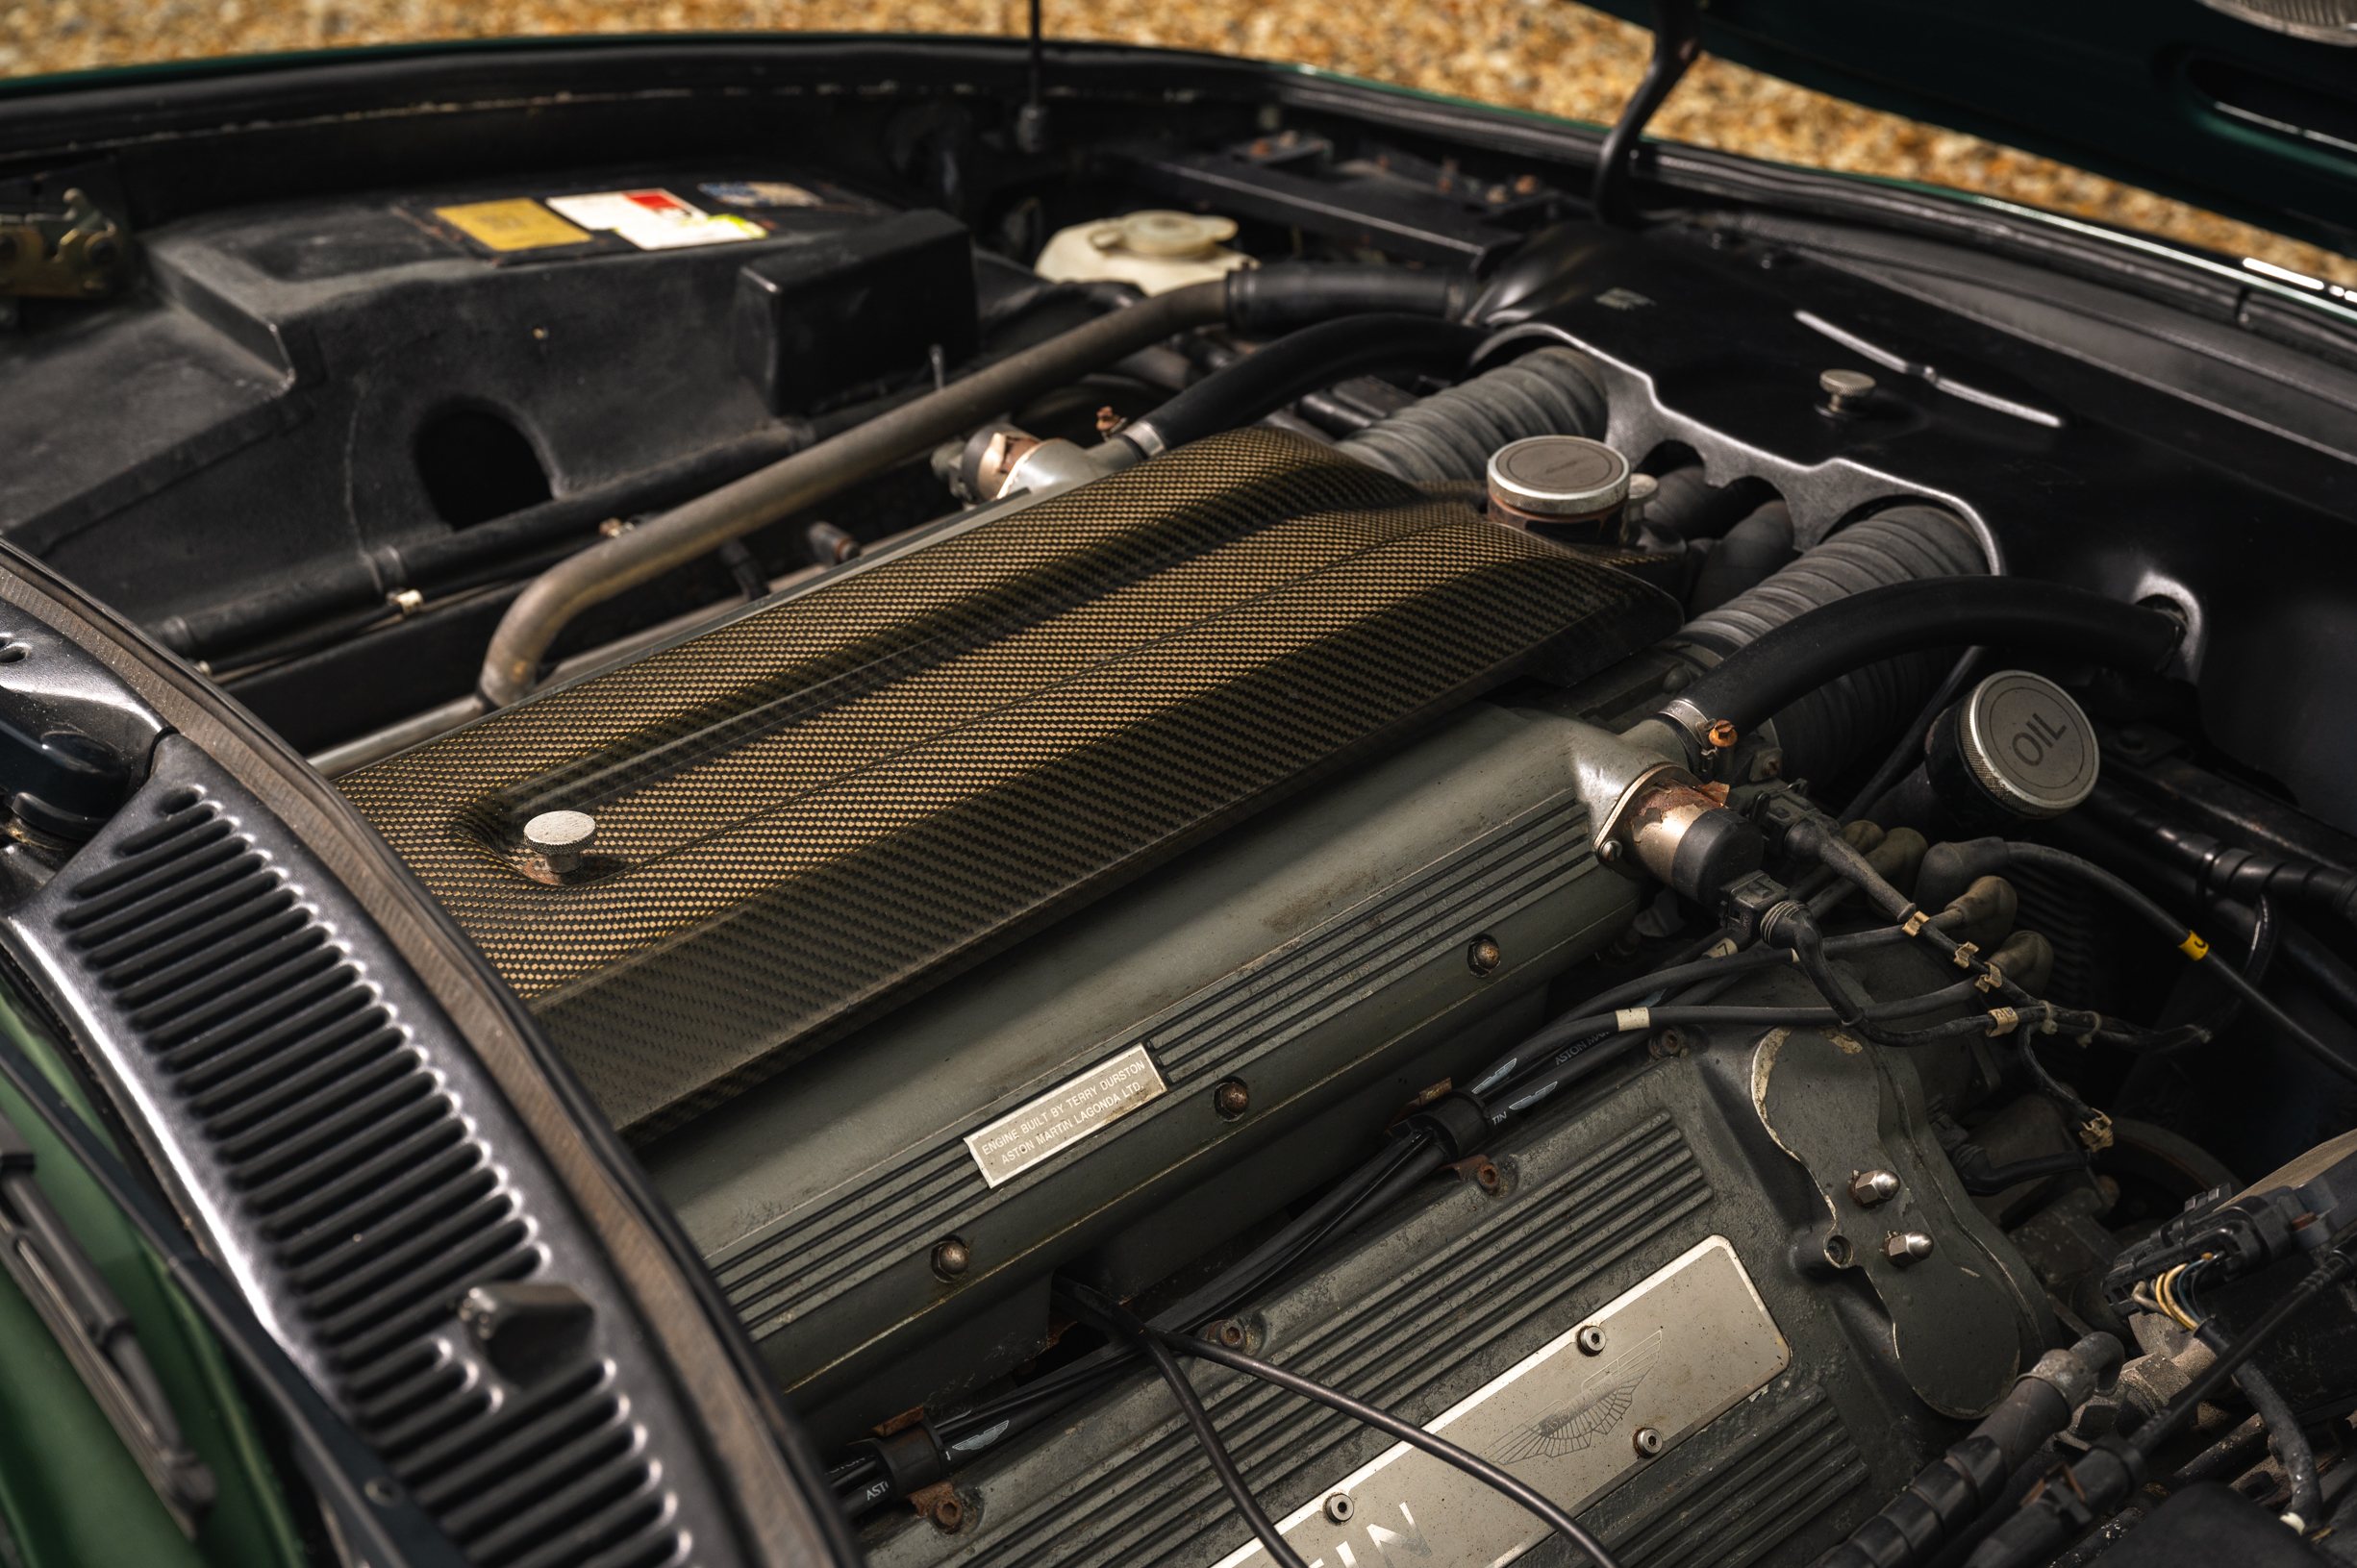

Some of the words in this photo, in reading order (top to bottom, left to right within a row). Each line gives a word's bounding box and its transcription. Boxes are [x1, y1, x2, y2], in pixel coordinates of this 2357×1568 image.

[2012, 712, 2068, 766] OIL
[1555, 1041, 1588, 1065] ASTON
[981, 1131, 1019, 1156] ENGINE
[1020, 1111, 1048, 1134] BUILT
[1050, 1104, 1066, 1118] BY
[1066, 1086, 1098, 1109] TERRY
[1099, 1060, 1145, 1090] DURSTON
[1000, 1139, 1035, 1165] ASTON
[1037, 1118, 1073, 1146] MARTIN
[1074, 1094, 1121, 1129] LAGONDA
[1121, 1082, 1144, 1099] LTD.
